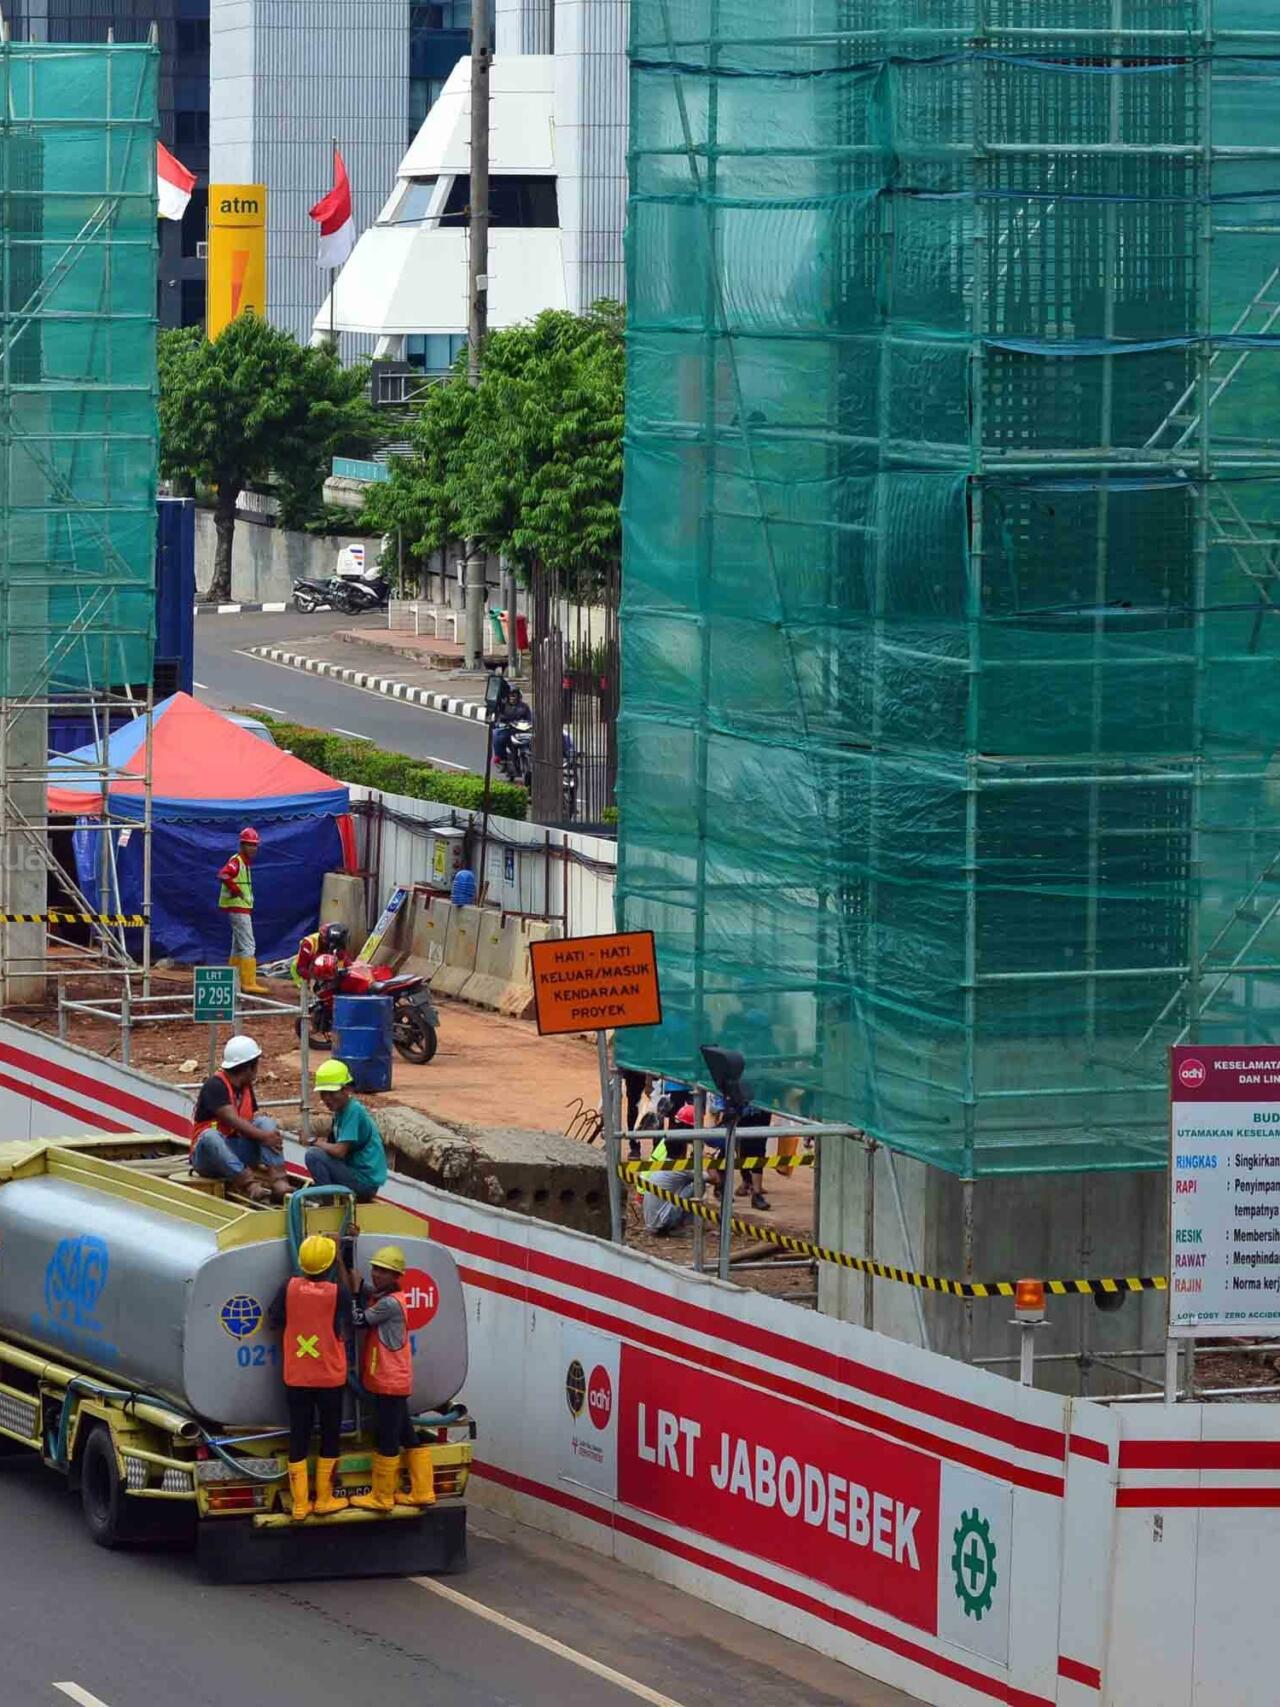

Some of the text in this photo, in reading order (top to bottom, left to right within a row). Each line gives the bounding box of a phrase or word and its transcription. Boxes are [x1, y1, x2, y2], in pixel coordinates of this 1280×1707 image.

[220, 197, 259, 213] atm
[555, 950, 585, 963] HATI
[600, 946, 630, 958] HATI
[206, 971, 222, 980] LRT
[540, 963, 649, 984] KELUAR/MASUK
[198, 987, 231, 1005] P 295
[554, 984, 639, 1002] KENDARAAN
[572, 1004, 626, 1019] PROYEK
[1181, 1068, 1203, 1078] adhi
[1239, 1075, 1260, 1084] DAN
[1177, 1129, 1233, 1137] UTAMAKAN
[1176, 1155, 1217, 1169] RINGKAS
[1235, 1153, 1280, 1170] Singkirkan
[1176, 1180, 1197, 1194] RAPI
[1235, 1178, 1280, 1195] Penyimpan
[1234, 1203, 1279, 1220] tempatnya
[1175, 1229, 1203, 1243] RESIK
[1233, 1228, 1280, 1242] Membersih
[1175, 1254, 1207, 1268] RAWAT
[1175, 1279, 1202, 1293] RAJIN
[1233, 1276, 1260, 1290] Norma
[404, 1287, 433, 1309] dhi
[590, 1387, 610, 1411] adhi
[638, 1402, 921, 1571] LRT JABODEBEK
